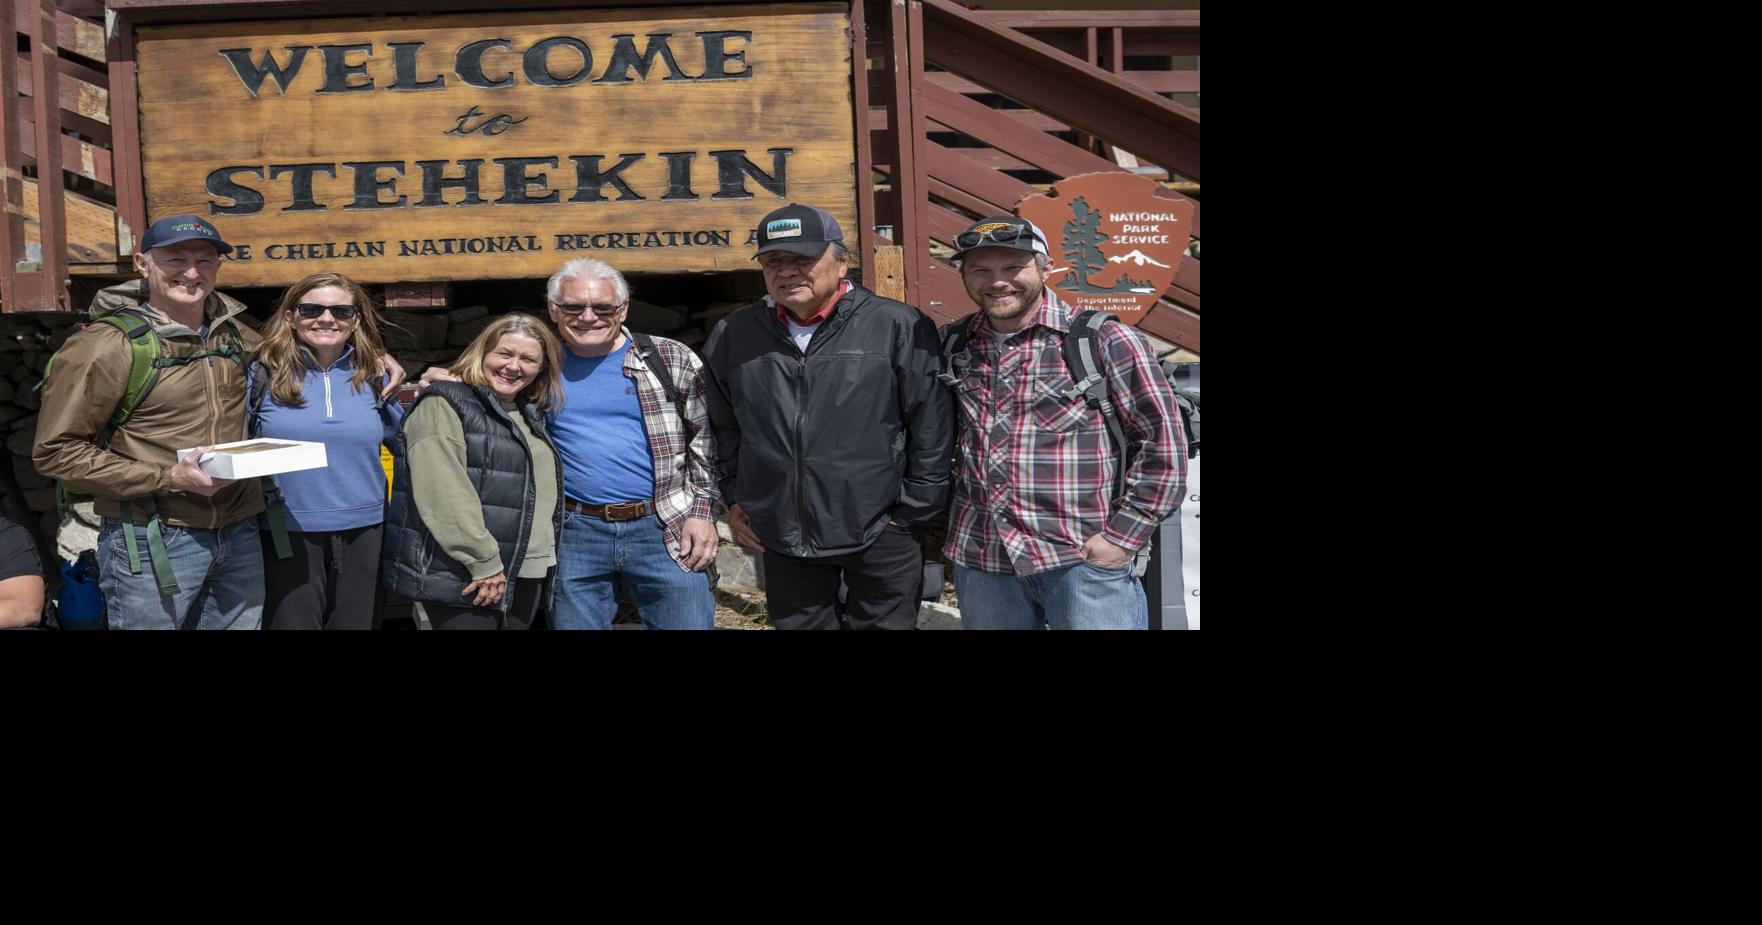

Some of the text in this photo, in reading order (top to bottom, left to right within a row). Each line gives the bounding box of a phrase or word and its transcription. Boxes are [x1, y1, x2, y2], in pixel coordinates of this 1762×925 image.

[219, 31, 753, 97] WELCOME
[443, 105, 529, 137] to
[205, 148, 794, 217] STEHEKIN
[1109, 212, 1178, 222] NATIONAL
[1122, 224, 1160, 233] PARK
[264, 240, 387, 262] CHELAN
[397, 235, 543, 258] NATIONAL
[554, 230, 733, 251] RECREATION
[1112, 235, 1170, 245] SERVICE
[1077, 296, 1137, 305] Department
